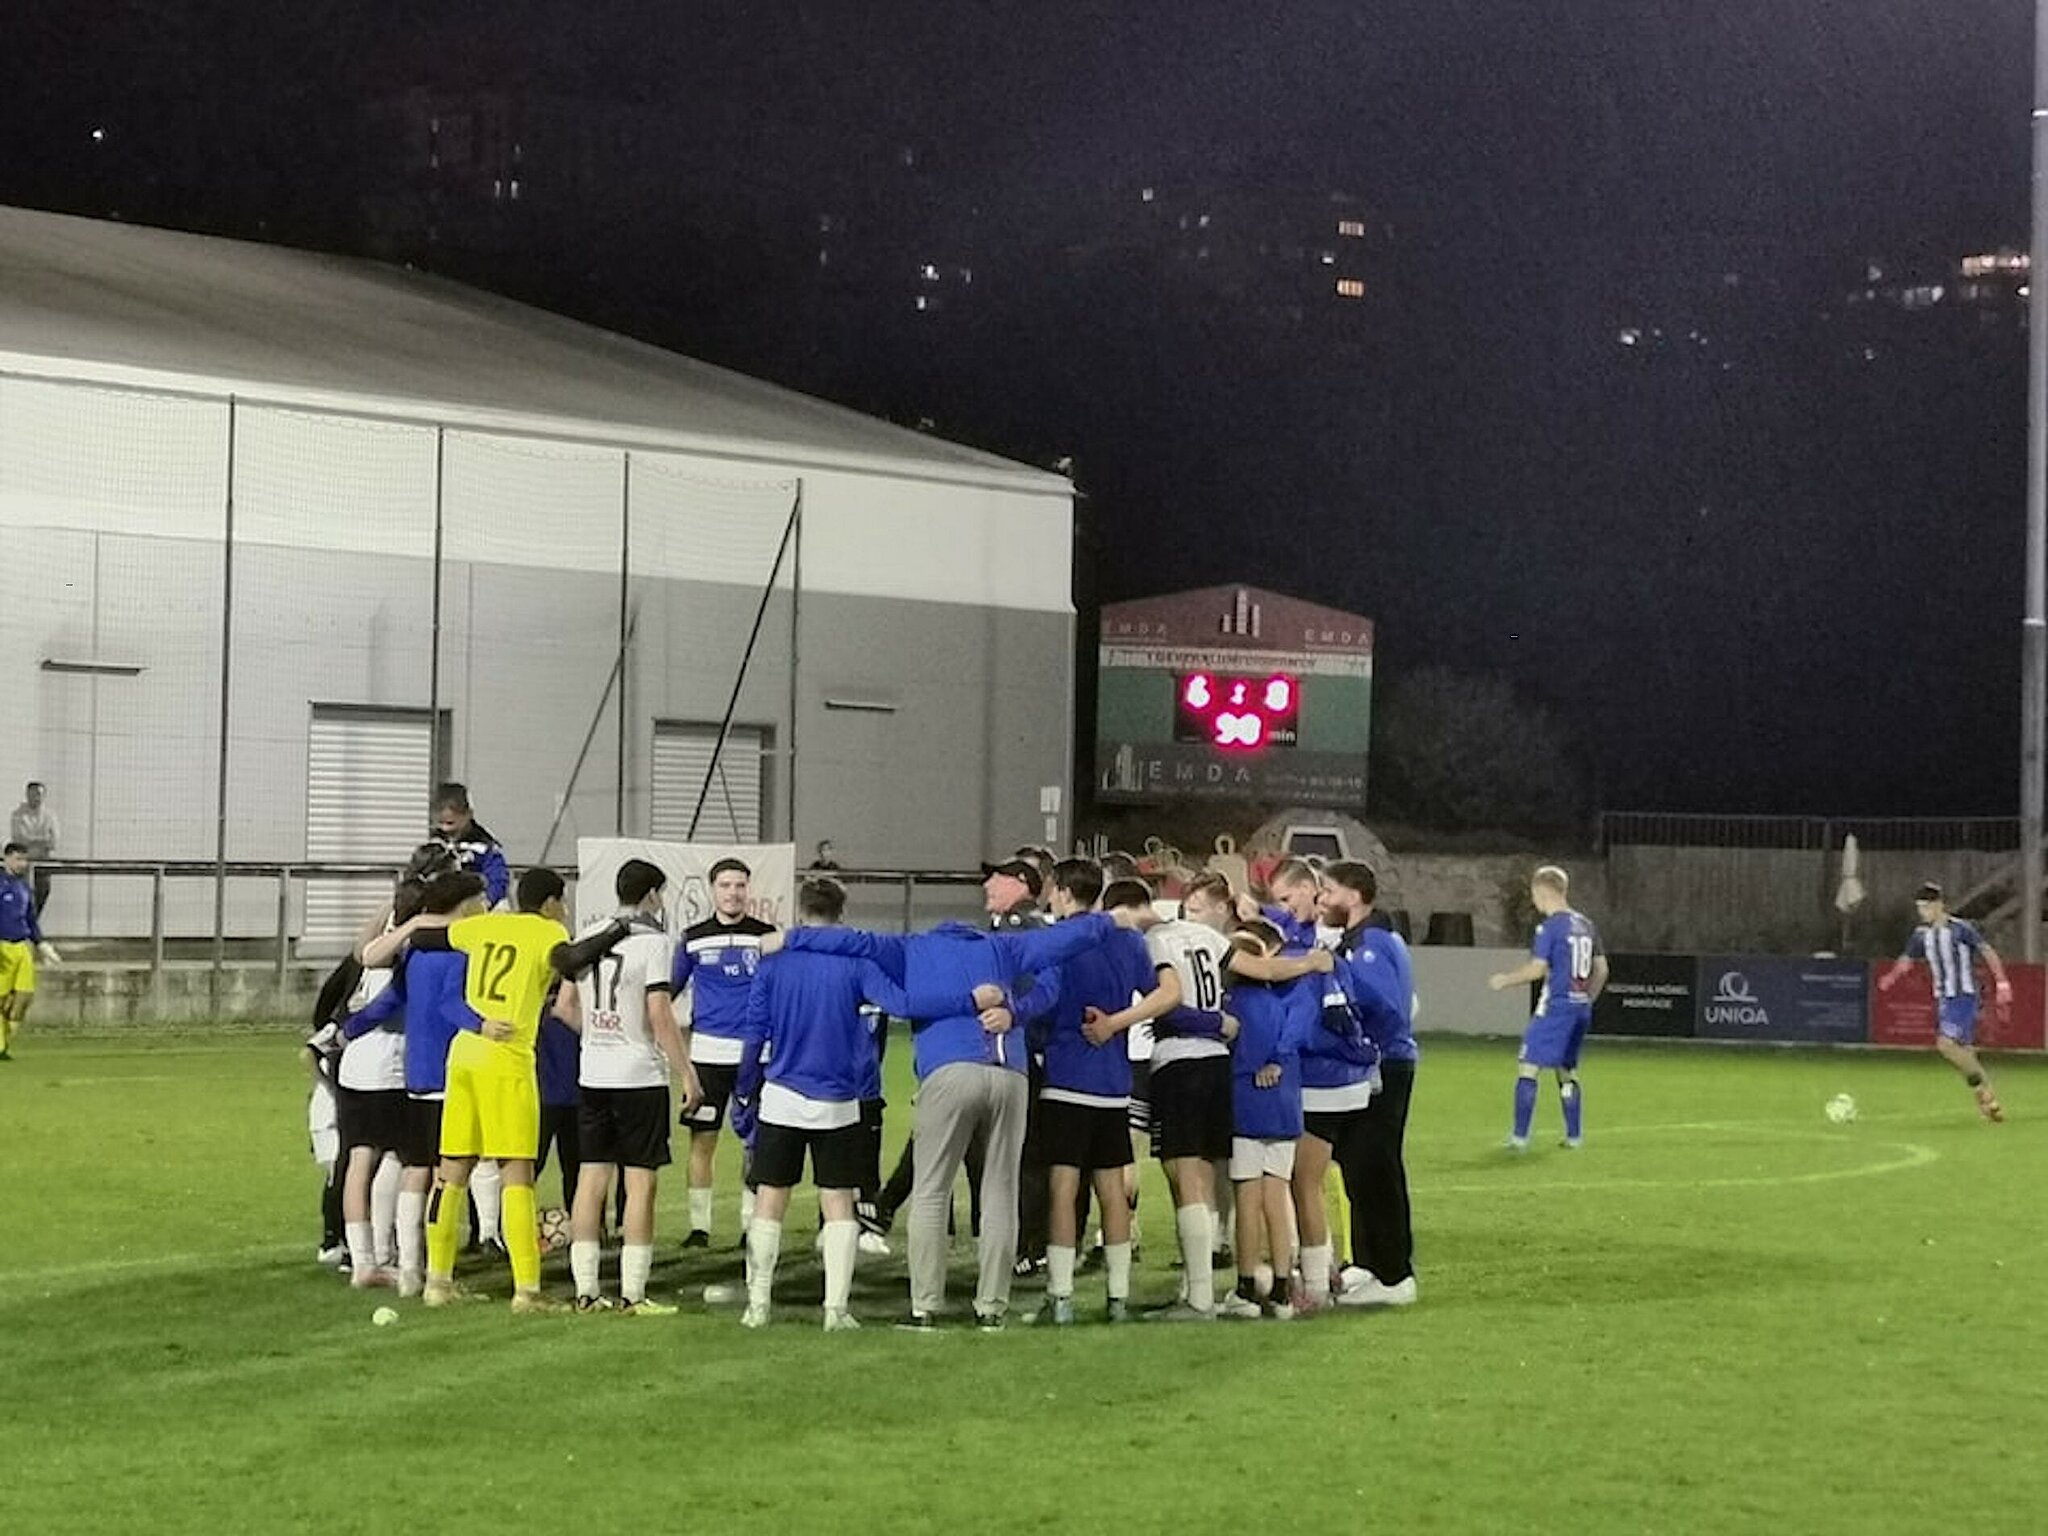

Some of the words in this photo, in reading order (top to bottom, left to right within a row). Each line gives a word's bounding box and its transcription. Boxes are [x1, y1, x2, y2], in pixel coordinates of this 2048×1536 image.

[477, 942, 517, 1002] 12
[593, 955, 623, 1011] 17
[1184, 948, 1215, 1012] 16
[1567, 936, 1592, 978] 18
[1704, 1006, 1770, 1025] UNIQA
